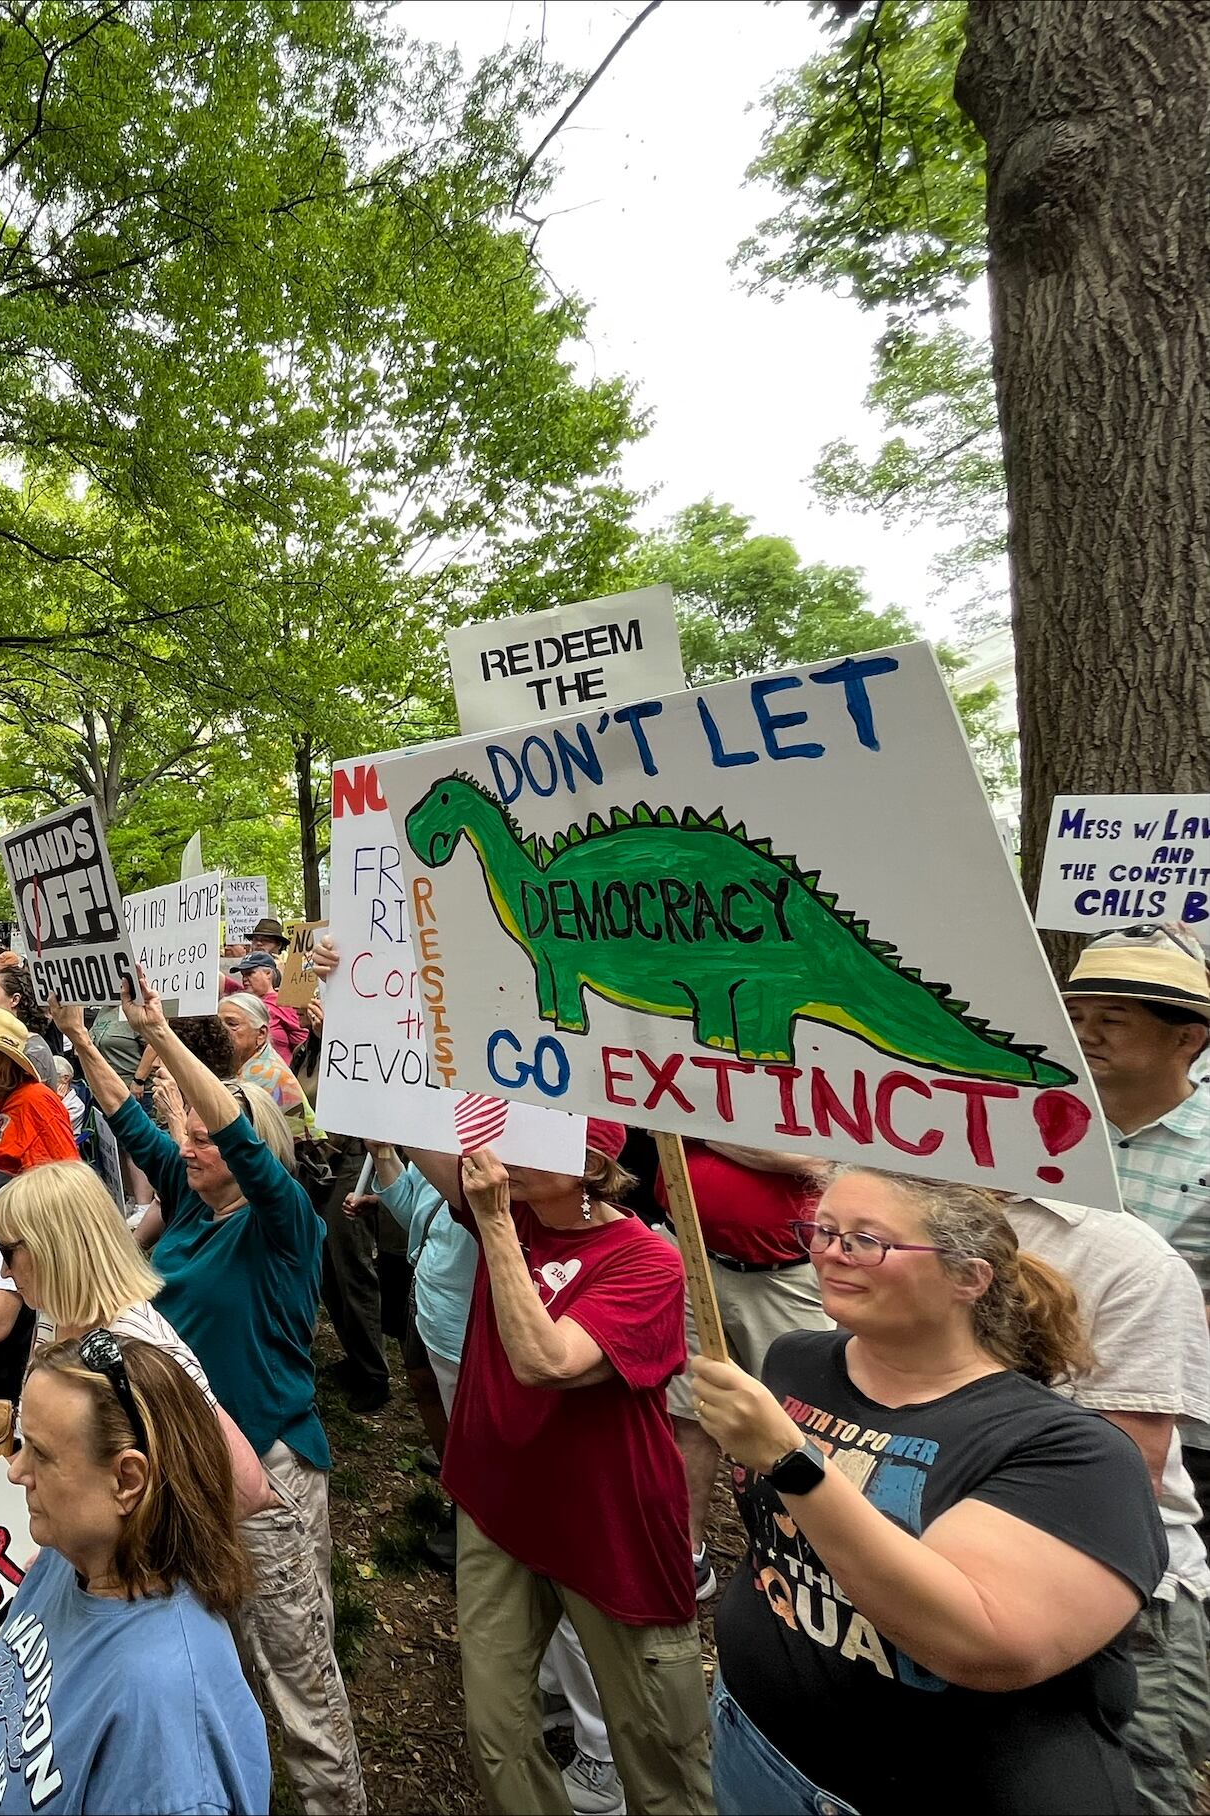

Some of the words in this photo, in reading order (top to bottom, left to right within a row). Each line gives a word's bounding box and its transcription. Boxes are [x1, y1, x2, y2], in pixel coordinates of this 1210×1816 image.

[480, 619, 643, 682] REDEEM
[526, 668, 607, 710] THE
[486, 700, 663, 804] DON'T
[696, 656, 899, 768] LET
[9, 817, 95, 881] HANDS
[1060, 864, 1096, 881] THE
[1151, 846, 1195, 864] AND
[22, 865, 114, 943] OFF!
[123, 897, 166, 933] Bring
[520, 877, 796, 946] DEMOCRACY
[1074, 889, 1167, 918] CALLS
[33, 952, 137, 1002] SCHOOLS
[140, 942, 207, 968] Albrego
[149, 970, 205, 993] arcia
[413, 877, 457, 1087] RESIST
[487, 1029, 570, 1098] GO
[602, 1045, 1092, 1184] EXTINCT!
[829, 1418, 858, 1443] TO
[856, 1426, 940, 1465] POWER
[3, 1610, 62, 1807] MADISON
